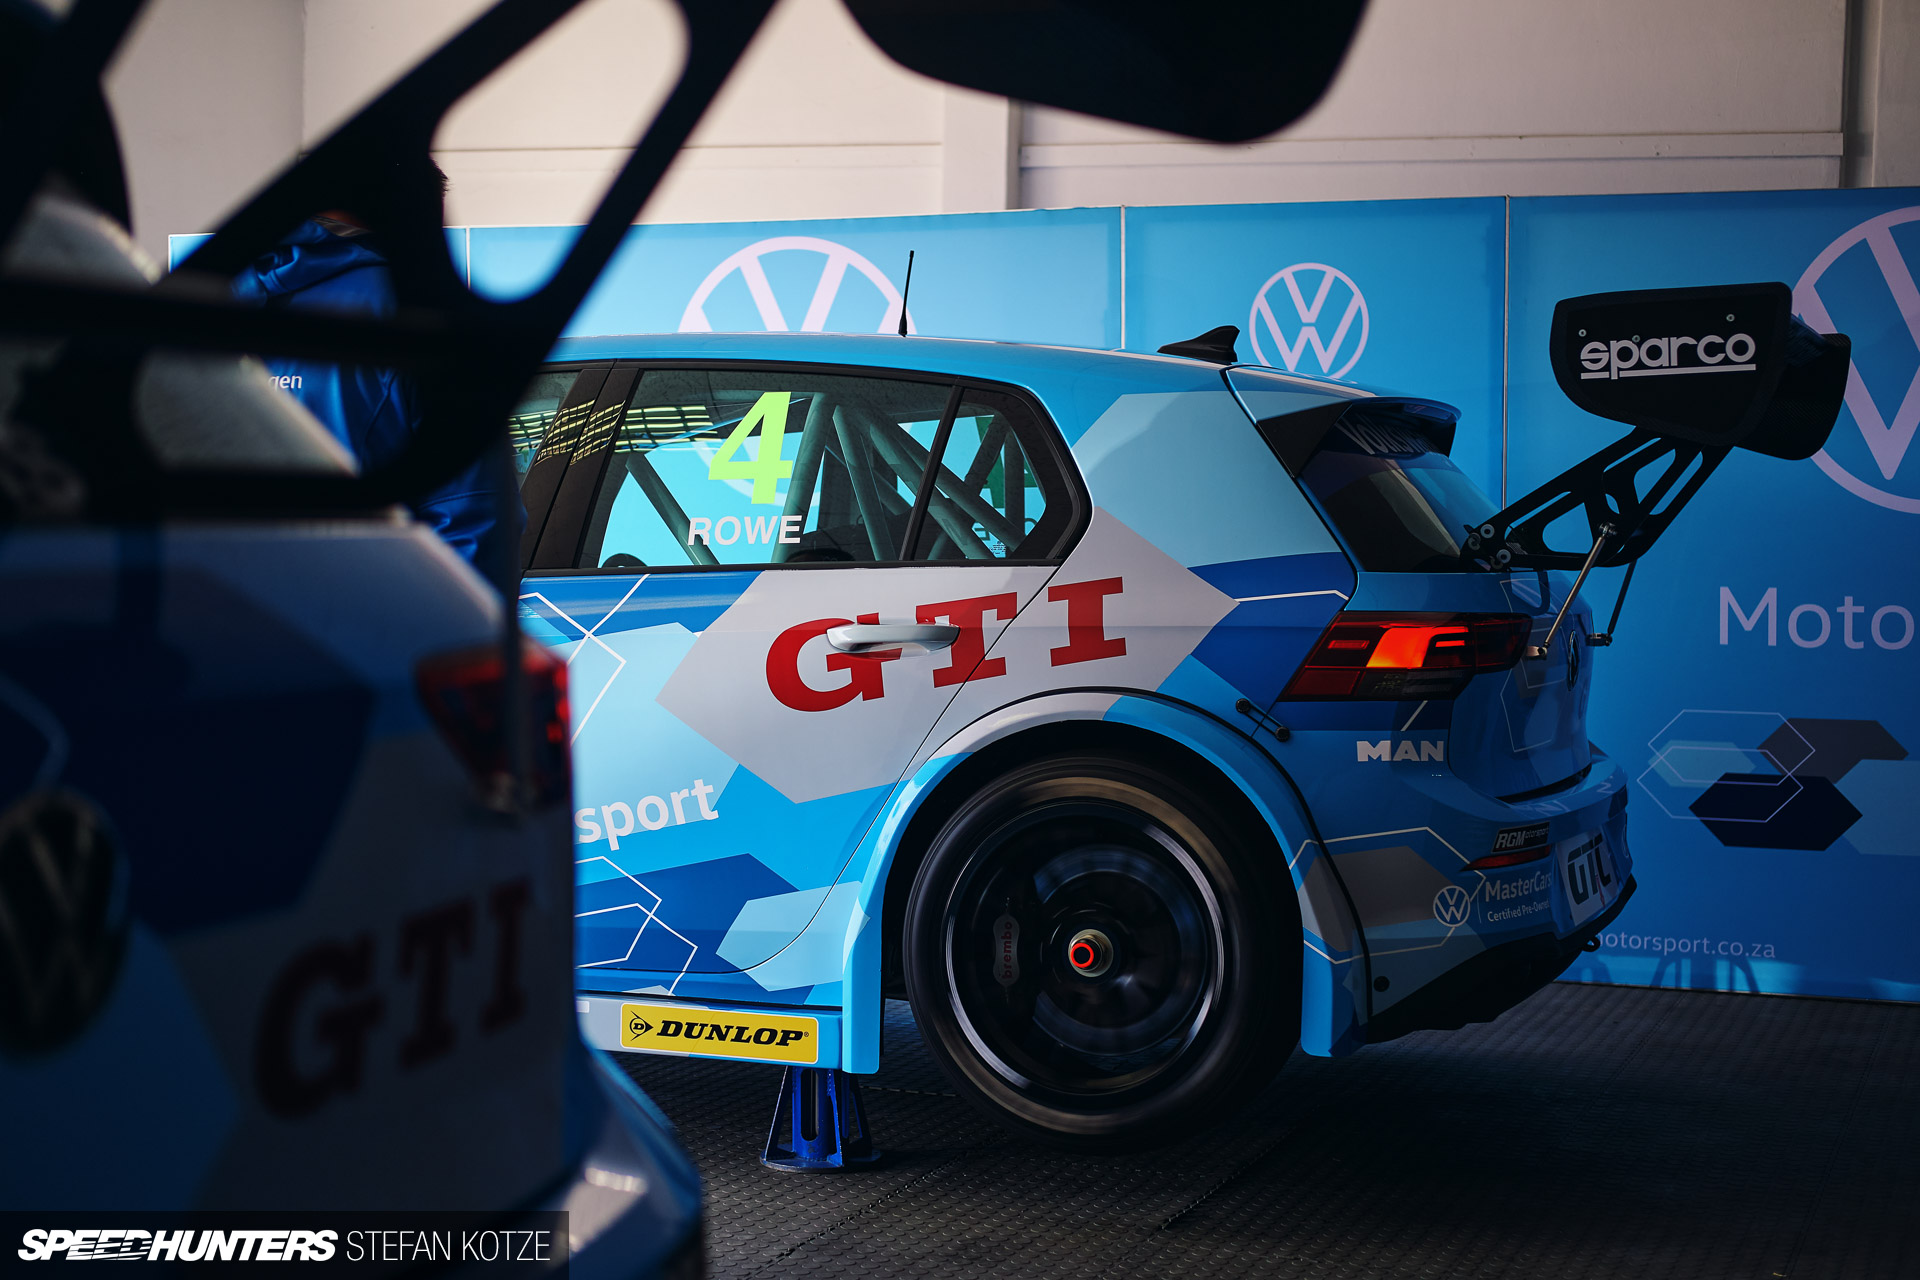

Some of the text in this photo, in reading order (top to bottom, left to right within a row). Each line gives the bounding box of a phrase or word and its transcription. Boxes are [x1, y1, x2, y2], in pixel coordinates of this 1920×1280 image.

[1580, 332, 1757, 380] sparco
[708, 391, 793, 504] 4
[687, 515, 802, 546] ROWE
[766, 576, 1127, 713] GTI
[1719, 586, 1915, 651] Moto
[1356, 740, 1444, 762] MAN
[575, 779, 719, 851] sport
[1485, 870, 1552, 902] MasterCars
[1487, 905, 1522, 922] Certified
[1001, 921, 1013, 979] brembo
[1597, 932, 1776, 958] otorsport.co.za
[255, 874, 531, 1121] GTI
